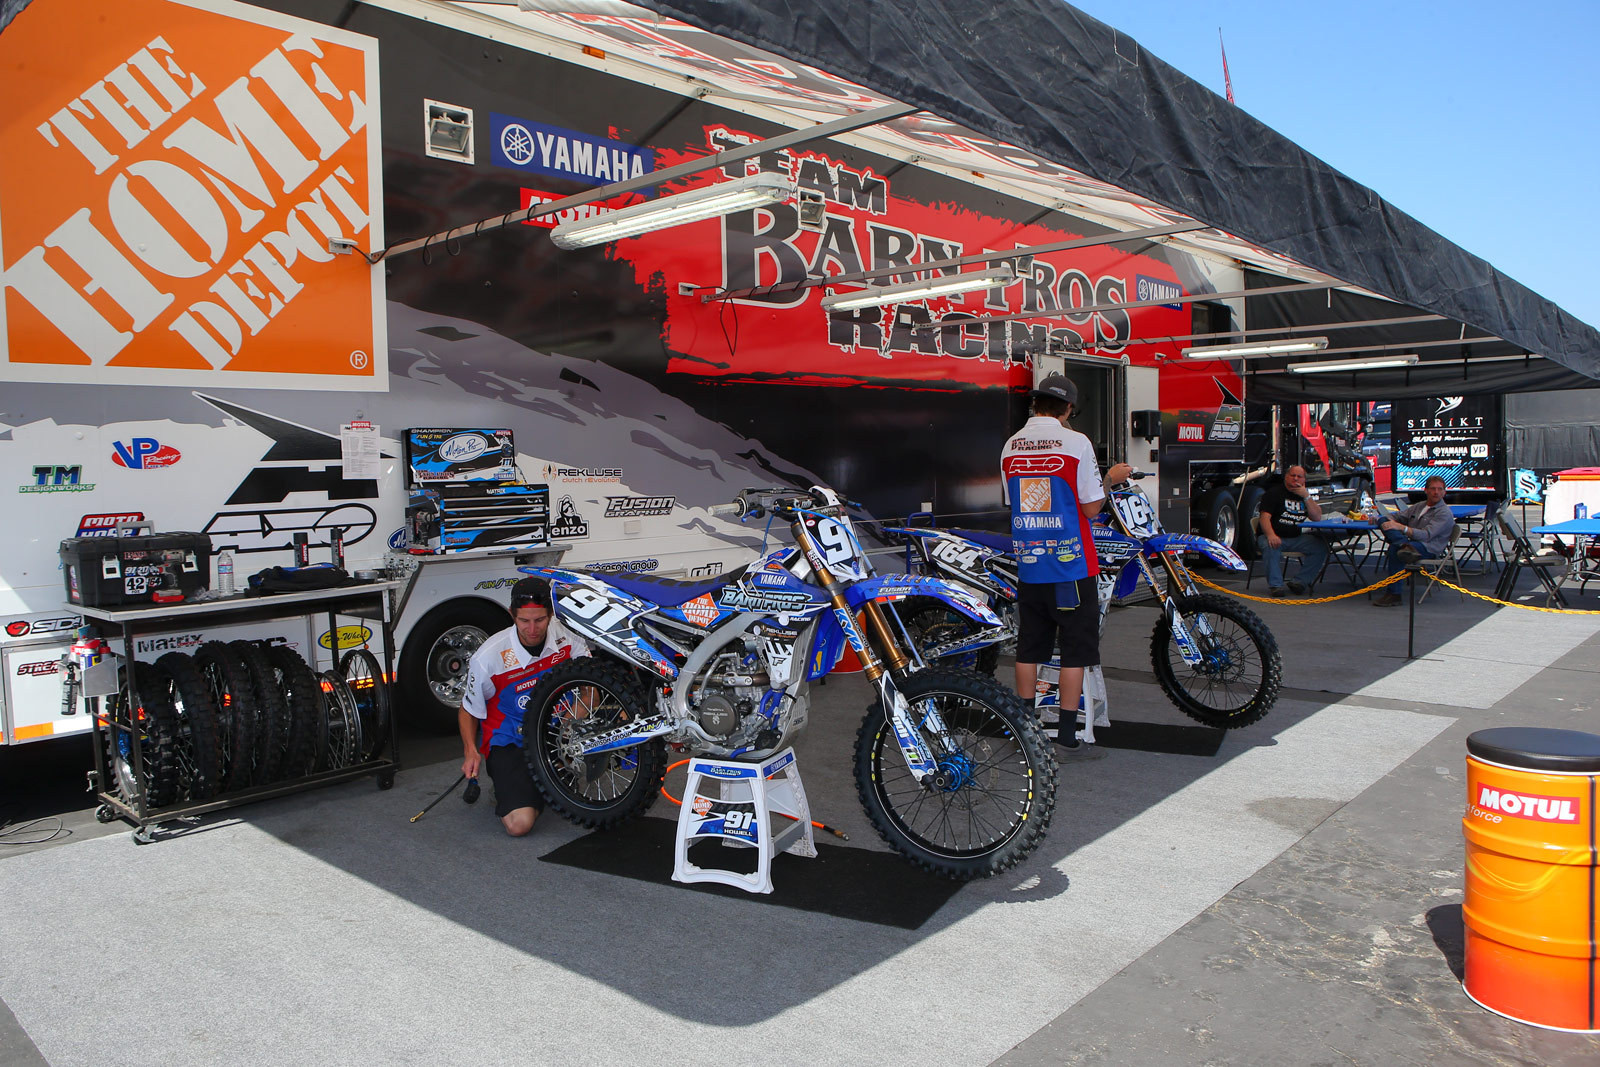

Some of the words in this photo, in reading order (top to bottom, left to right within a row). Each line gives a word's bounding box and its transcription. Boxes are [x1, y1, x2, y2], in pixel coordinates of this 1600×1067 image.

[36, 35, 207, 175] THE
[536, 131, 644, 183] YAMAHA
[3, 32, 367, 366] HOME
[168, 165, 370, 371] DEPOT
[983, 242, 1132, 354] PROS
[1179, 427, 1203, 440] MOTUL
[112, 437, 160, 469] VP
[1037, 439, 1064, 448] PROS
[1440, 446, 1468, 454] YAMAHA
[33, 466, 82, 486] TM
[557, 468, 623, 477] REKLUSE
[19, 484, 94, 493] DESIGNWORKS
[1021, 478, 1050, 512] HOME
[551, 525, 587, 536] enzo
[1022, 516, 1062, 529] YAMAHA
[1092, 530, 1113, 538] AMAHA
[931, 540, 979, 571] 164
[630, 561, 658, 571] GROUP
[126, 577, 146, 591] 42
[760, 574, 788, 586] YAMAHA
[558, 588, 633, 632] 91
[138, 634, 203, 653] Matrix
[1479, 787, 1576, 821] MOTUL
[723, 810, 754, 830] 91
[1470, 805, 1503, 824] force
[723, 828, 753, 837] HOWELL
